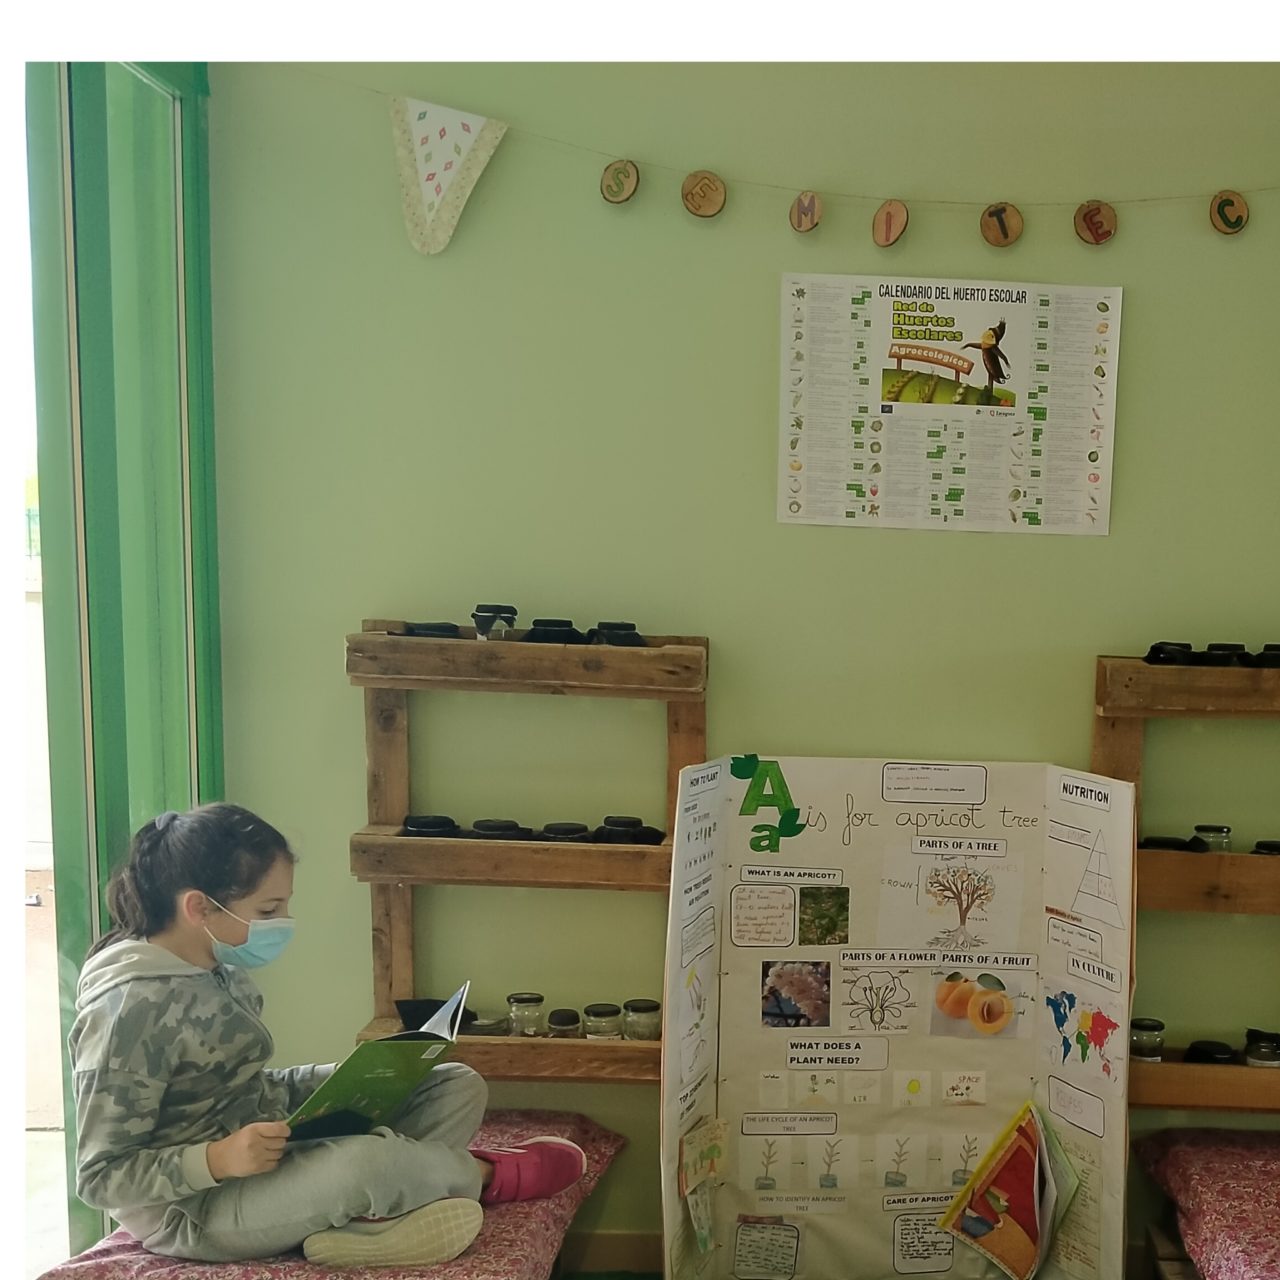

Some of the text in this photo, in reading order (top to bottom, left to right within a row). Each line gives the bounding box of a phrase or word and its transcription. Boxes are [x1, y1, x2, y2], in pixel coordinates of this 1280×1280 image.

[879, 284, 1027, 304] CALENDARIO DEL HUERTO ESCOLAR
[893, 301, 935, 313] Red de
[893, 313, 955, 327] Huertos
[892, 327, 963, 341] Escolares
[739, 761, 796, 816] A
[1062, 782, 1109, 804] NUTRITION
[804, 793, 1039, 846] is for apricot tree
[920, 839, 999, 851] PARTS OF A TREE
[747, 869, 771, 877] WHAT
[797, 872, 836, 880] APRICOT?
[842, 953, 936, 962] PARTS OF A FLOWER
[942, 954, 1031, 966] PARTS OF A FRUIT
[1072, 957, 1116, 983] IN CULTURE
[790, 1042, 862, 1050] WHAT DOES A
[827, 1057, 860, 1065] NEED?
[921, 1196, 954, 1204] APRICOT
